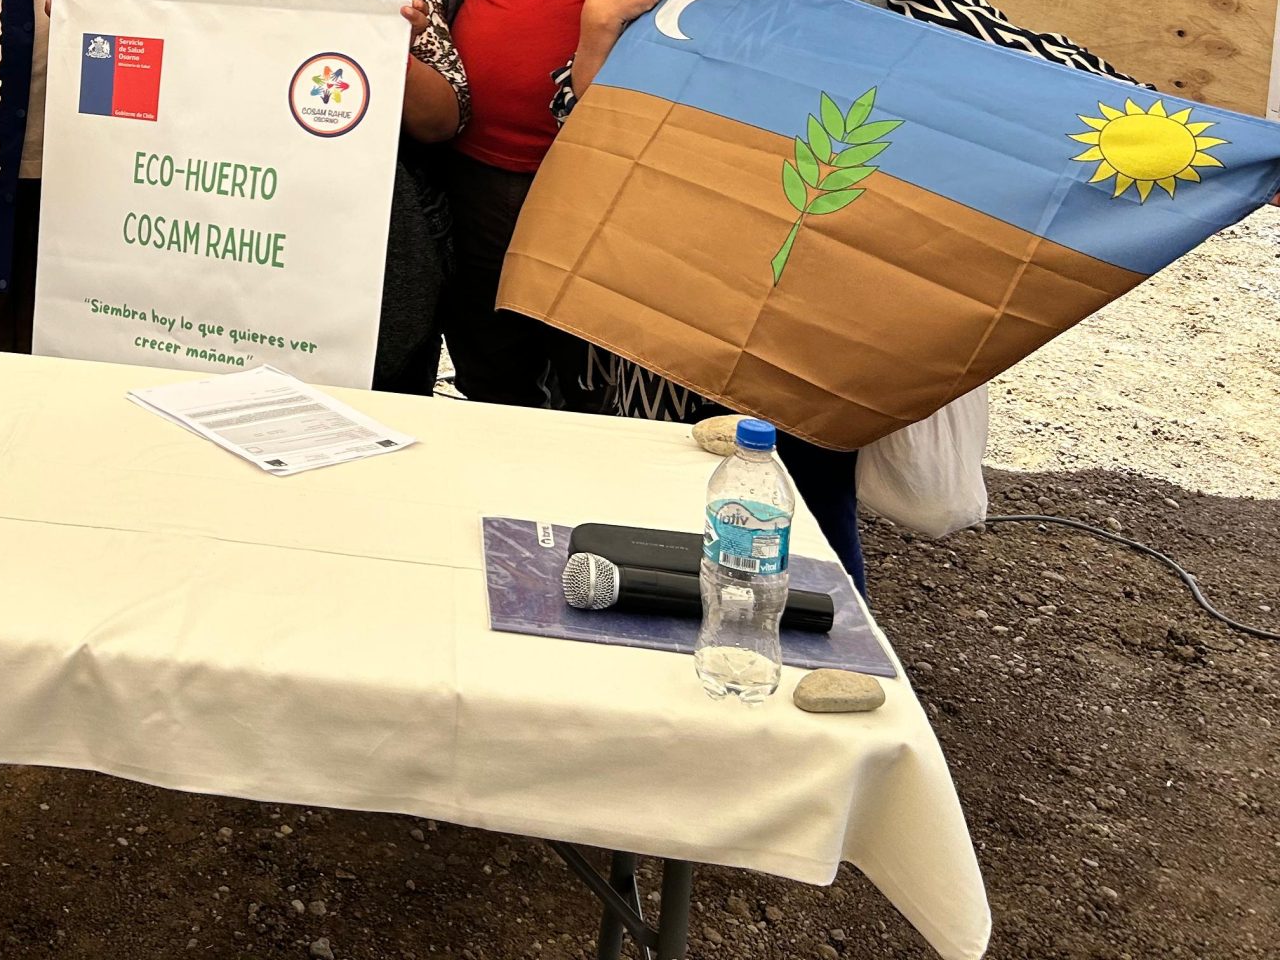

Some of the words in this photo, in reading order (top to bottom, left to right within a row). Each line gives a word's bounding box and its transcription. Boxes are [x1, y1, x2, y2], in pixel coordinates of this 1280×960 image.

[119, 38, 144, 46] Servicio
[127, 46, 145, 54] Salud
[118, 53, 140, 61] Osorno
[301, 107, 327, 116] COSAM
[327, 109, 352, 119] RAHUE
[133, 151, 278, 201] ECO-HUERTO
[123, 212, 200, 255] COSAM
[205, 223, 287, 268] RAHUE
[151, 308, 177, 332] hoy
[180, 315, 193, 330] lo
[198, 323, 224, 338] que
[229, 328, 285, 348] quieres
[290, 340, 317, 354] ver
[134, 336, 181, 354] crecer
[760, 563, 777, 572] vital
